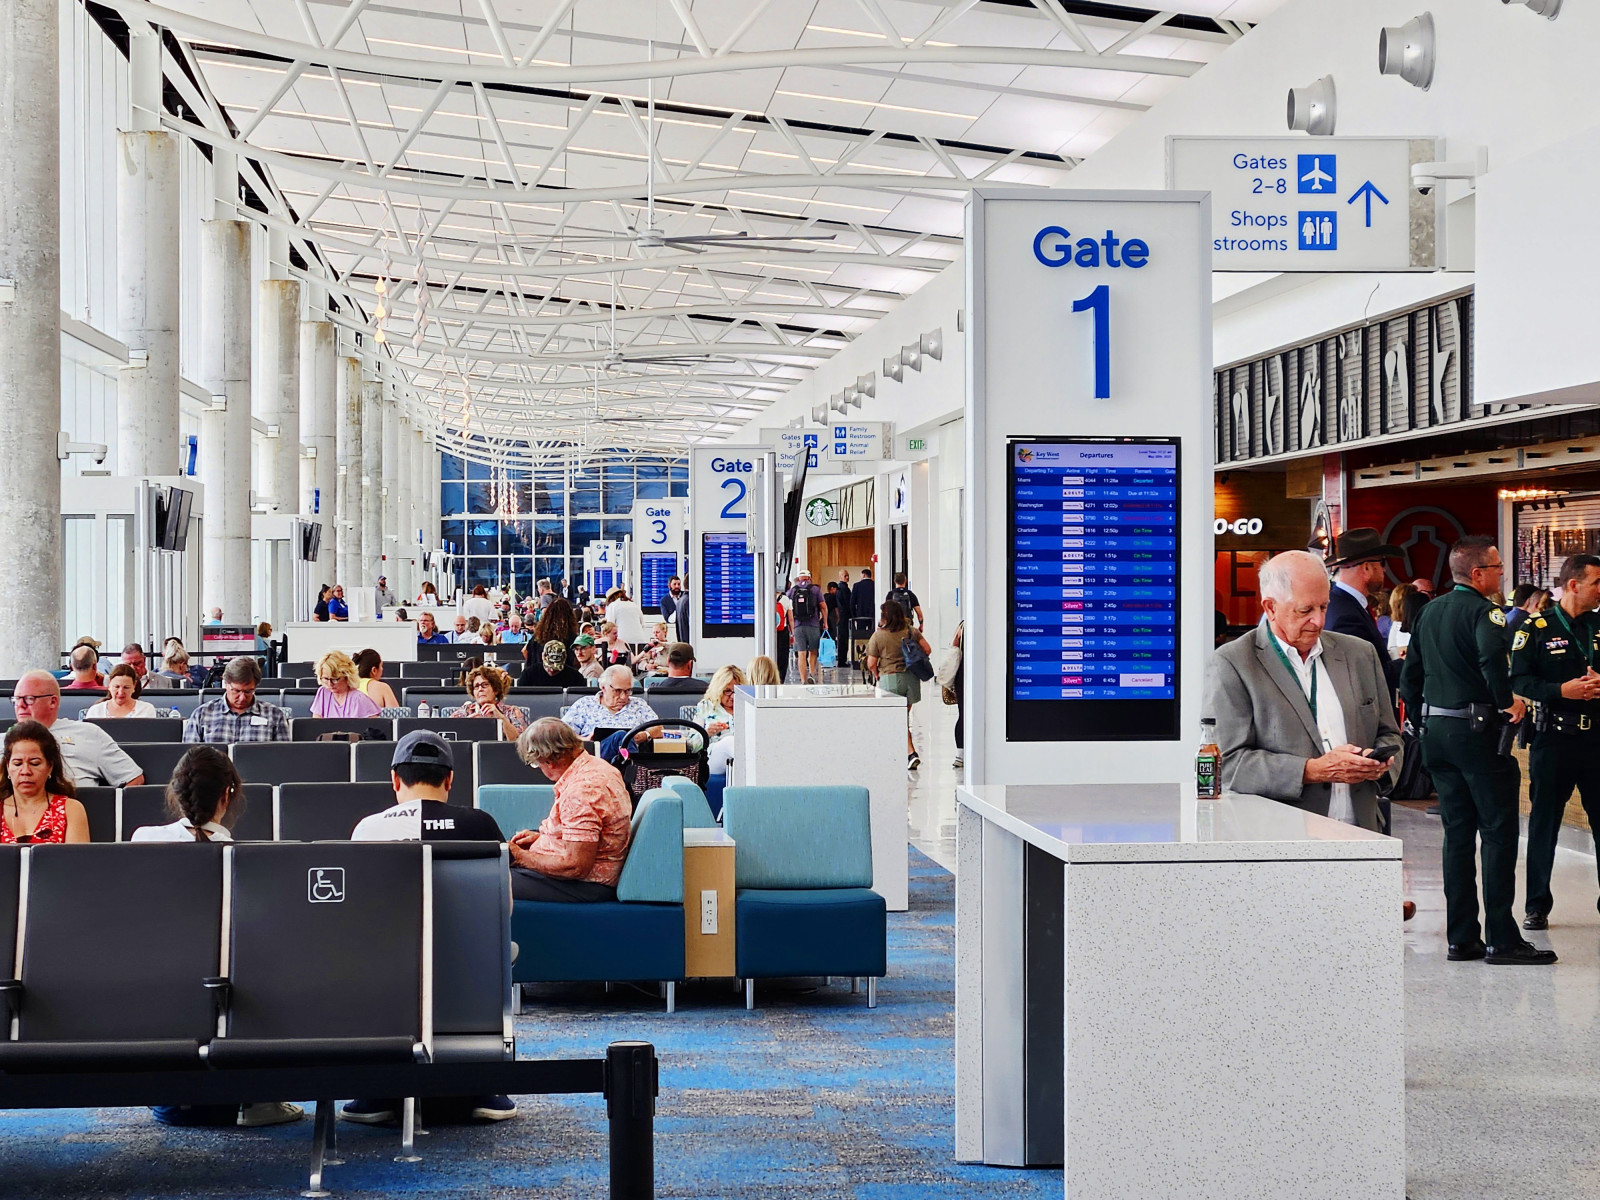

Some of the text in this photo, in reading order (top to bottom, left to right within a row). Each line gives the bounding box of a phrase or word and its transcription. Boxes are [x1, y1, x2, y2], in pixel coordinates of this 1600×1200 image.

[1233, 153, 1287, 170] Gates
[1252, 177, 1287, 194] 2-8
[1231, 210, 1288, 231] Shops
[1032, 226, 1150, 269] Gate
[1213, 236, 1288, 251] strooms
[1070, 285, 1111, 400] 1
[849, 426, 868, 434] Family
[909, 440, 922, 450] EXIT
[711, 457, 753, 473] Gate
[720, 478, 747, 519] 2
[645, 507, 671, 518] Gate
[651, 519, 668, 544] 3
[1213, 517, 1263, 535] O·GO
[598, 550, 608, 564] 4
[383, 808, 418, 819] MAY
[423, 819, 455, 831] THE
